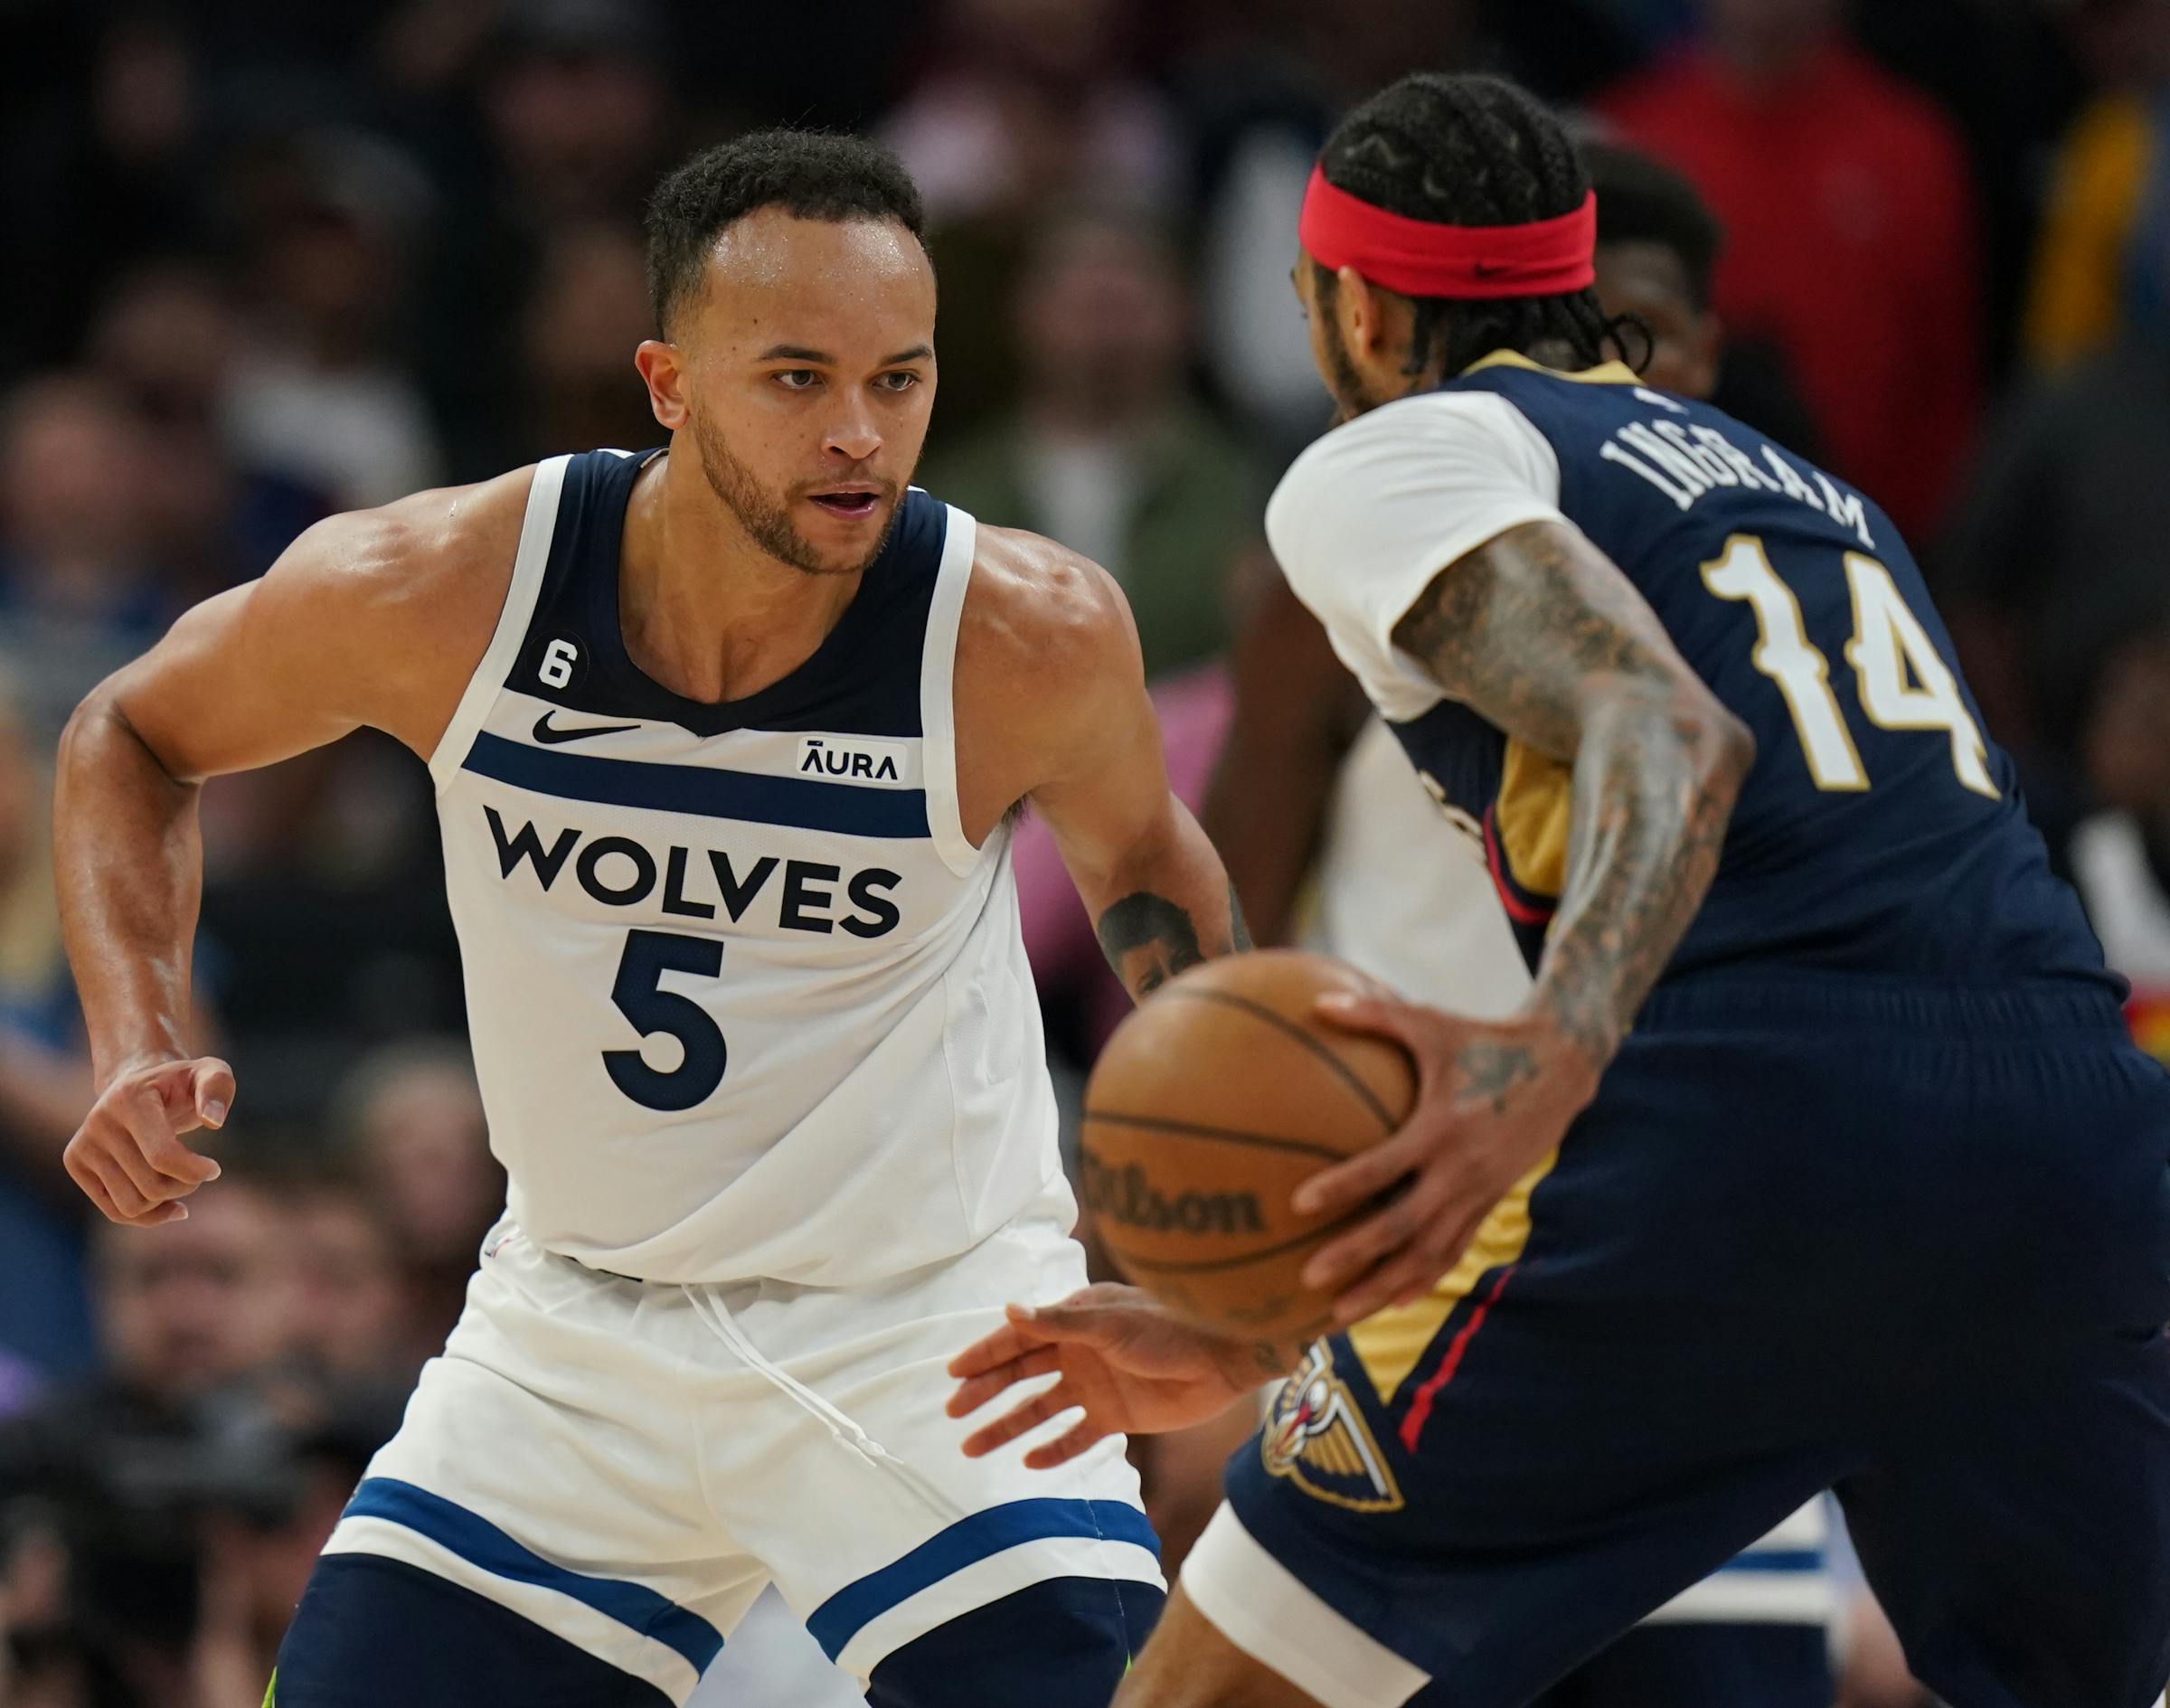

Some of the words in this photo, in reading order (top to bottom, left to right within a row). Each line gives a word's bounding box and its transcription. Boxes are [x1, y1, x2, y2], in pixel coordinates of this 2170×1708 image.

[1599, 419, 1876, 550] INGRAM
[538, 638, 578, 689] 6
[1700, 533, 2002, 801] 14
[483, 805, 902, 939] WOLVES
[601, 928, 727, 1111] 5
